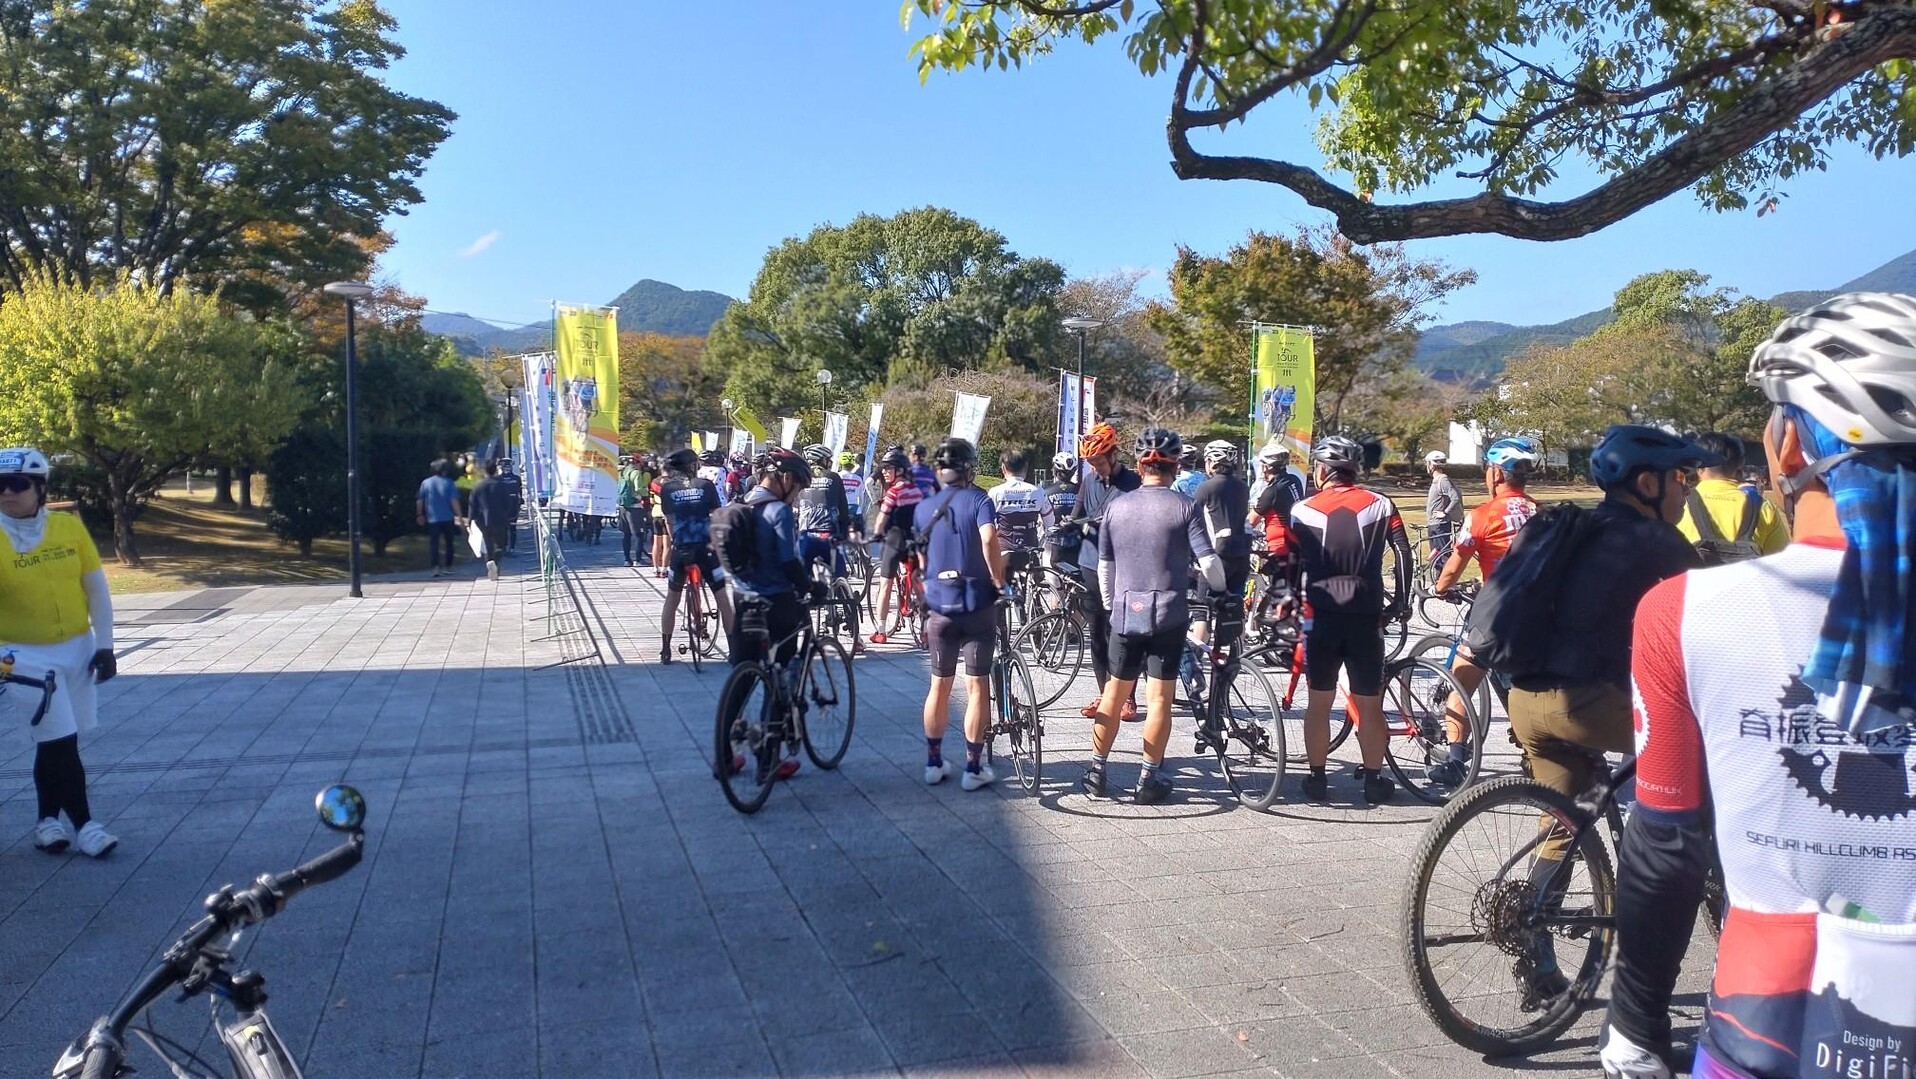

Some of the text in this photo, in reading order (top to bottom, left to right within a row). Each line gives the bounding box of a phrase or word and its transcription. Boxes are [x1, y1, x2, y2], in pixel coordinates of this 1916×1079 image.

[1277, 353, 1299, 362] TOUR
[13, 556, 41, 569] TOUR
[1746, 830, 1800, 851] SEFURI
[1804, 841, 1888, 859] HILLCLIMB
[1843, 1030, 1902, 1052] Design by
